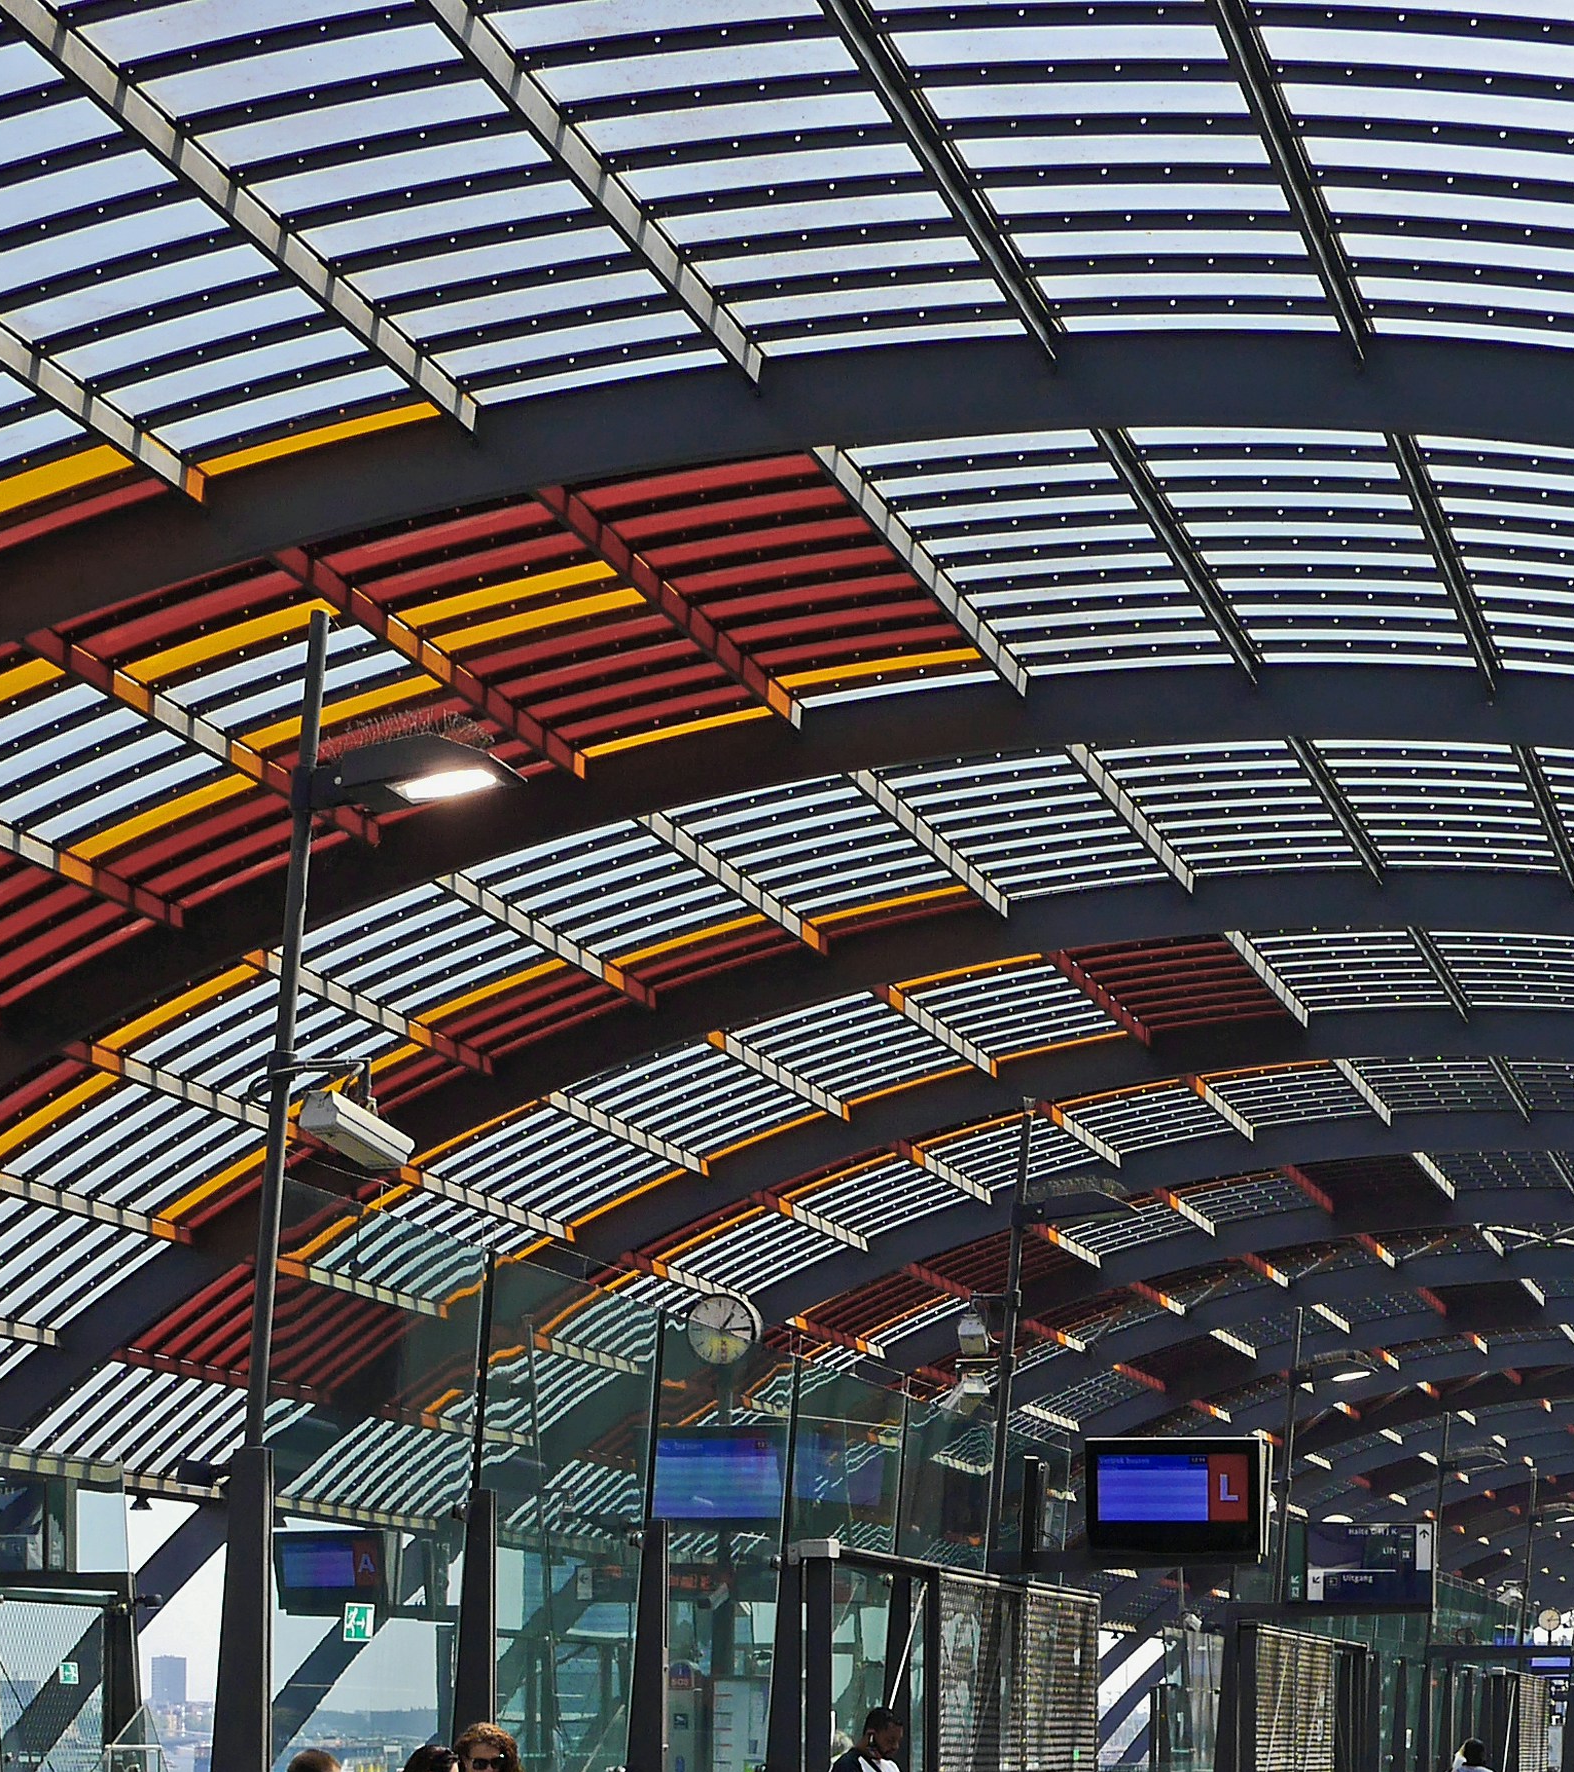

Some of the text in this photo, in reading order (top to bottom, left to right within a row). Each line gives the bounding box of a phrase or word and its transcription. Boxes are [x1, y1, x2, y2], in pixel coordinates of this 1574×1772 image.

[1219, 1473, 1239, 1501] L
[1382, 1546, 1397, 1555] Lift
[358, 1553, 376, 1573] A
[1342, 1574, 1373, 1584] Uitgang
